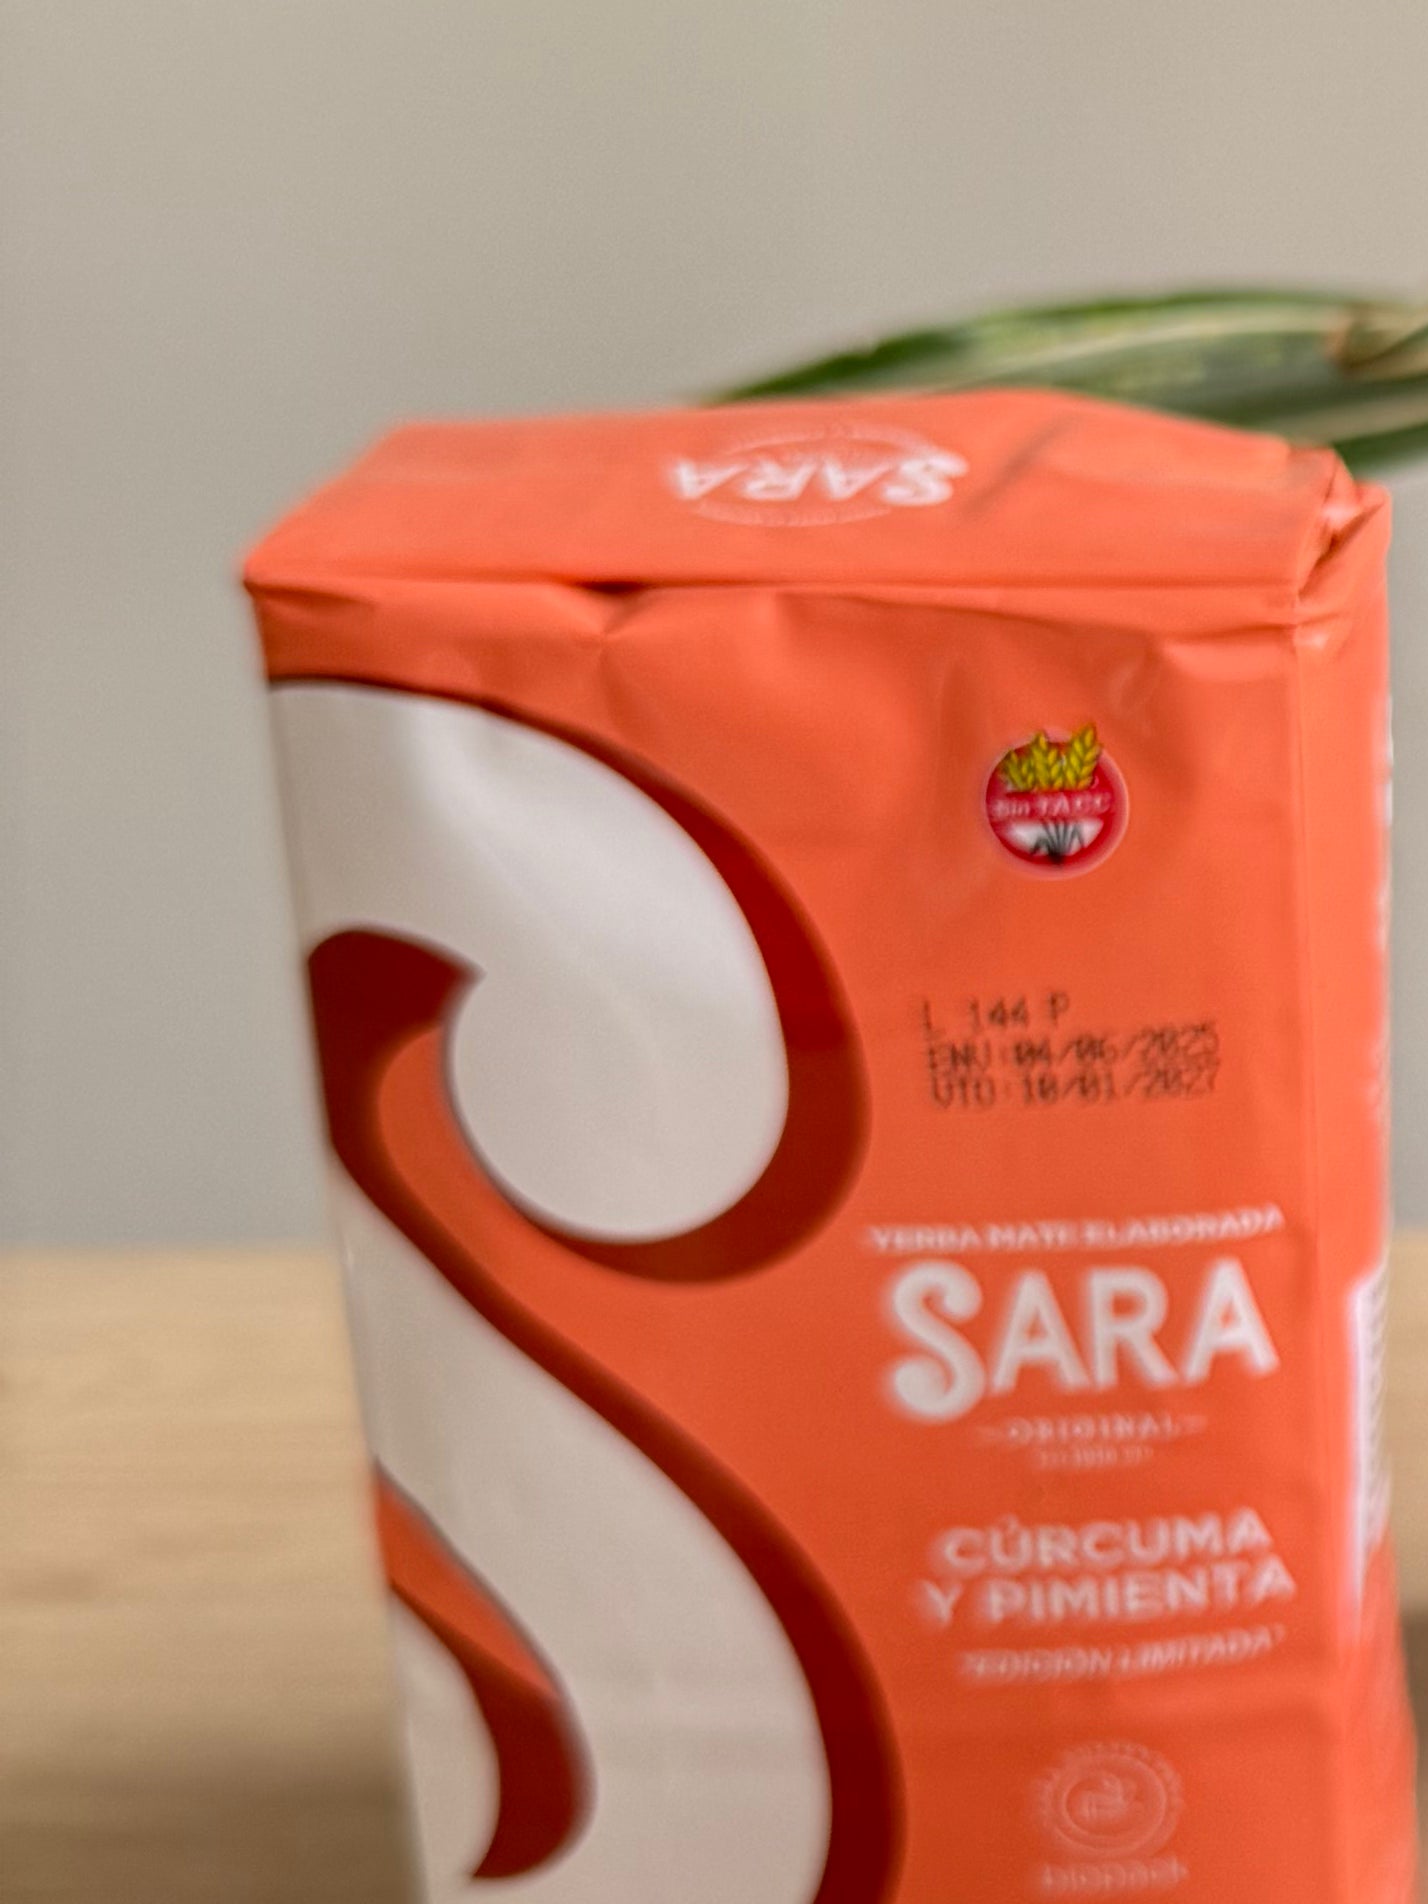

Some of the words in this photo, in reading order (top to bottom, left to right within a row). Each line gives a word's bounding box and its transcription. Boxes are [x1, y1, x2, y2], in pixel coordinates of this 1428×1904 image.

[668, 446, 968, 507] SARA
[889, 1256, 1278, 1422] SARA
[918, 1580, 960, 1627] Y
[988, 1556, 1296, 1624] PIMIENTA
